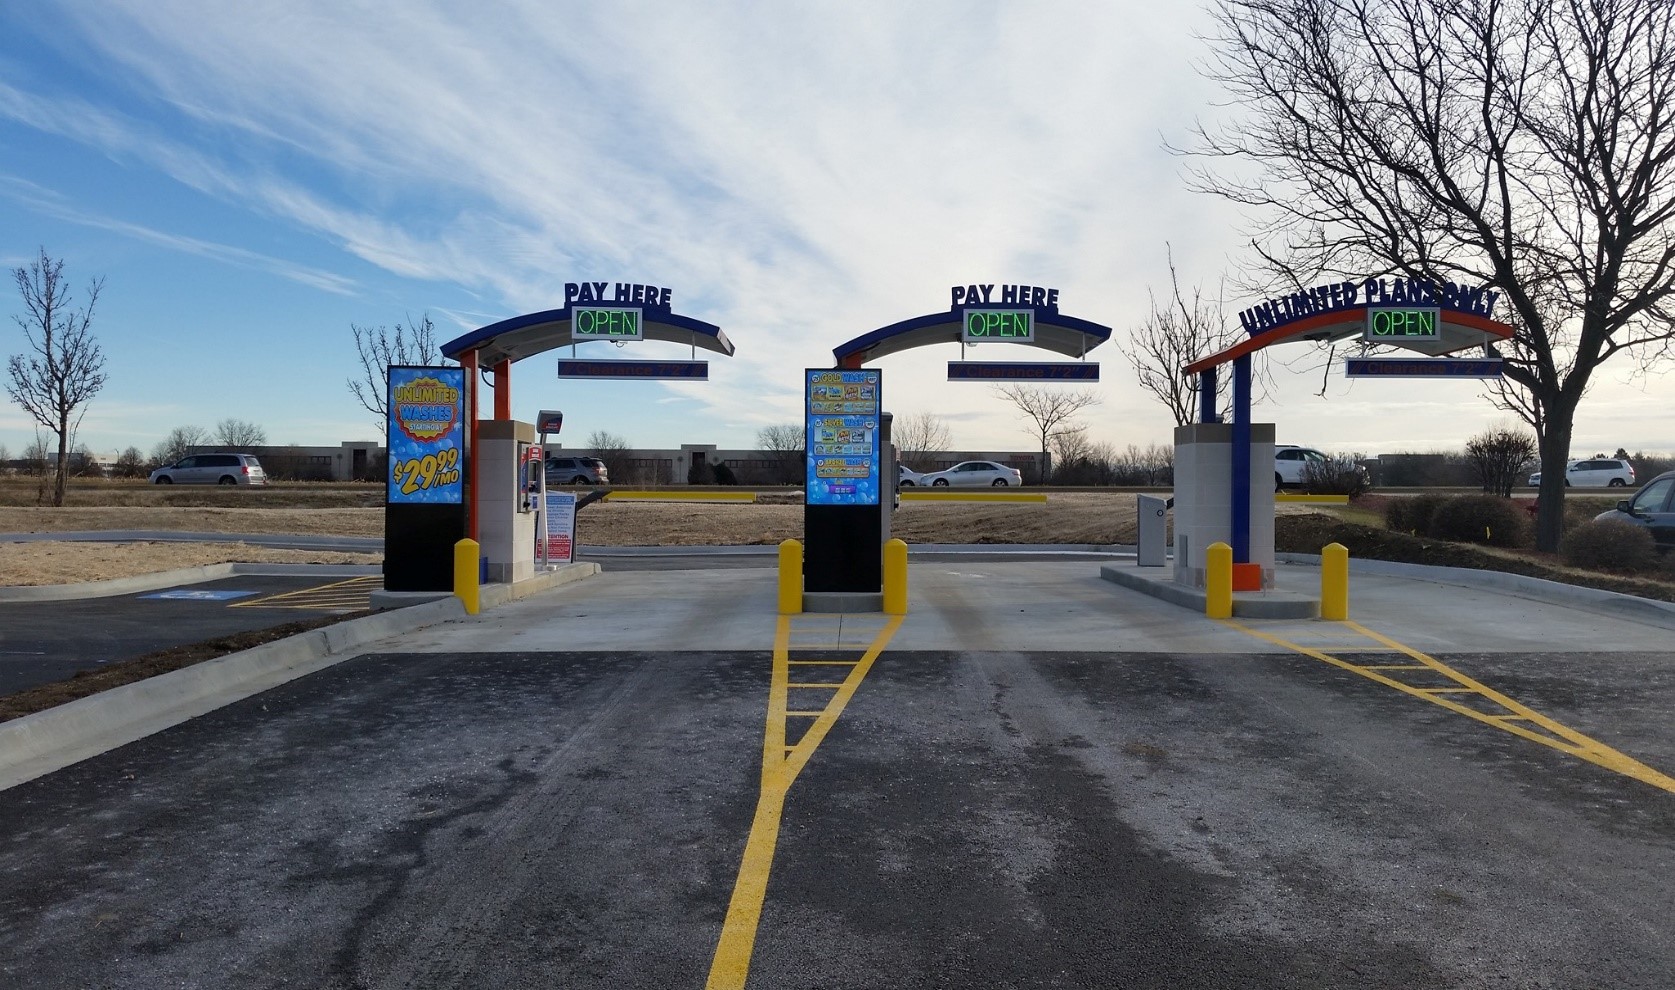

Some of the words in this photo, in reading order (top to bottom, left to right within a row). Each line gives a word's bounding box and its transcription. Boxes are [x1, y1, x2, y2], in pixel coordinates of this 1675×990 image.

[564, 282, 608, 303] PAY
[615, 282, 672, 307] HERE
[951, 284, 994, 306] PAY
[1002, 284, 1059, 308] HERE
[1239, 282, 1358, 332] UNLIMITED
[1365, 278, 1438, 305] PLANS
[578, 310, 636, 335] OPEN
[969, 312, 1028, 337] OPEN
[1373, 311, 1433, 336] OPEN
[576, 364, 653, 376] Clearance
[821, 371, 841, 382] GOLD
[842, 371, 865, 383] WASH
[967, 365, 1044, 378] Clearance
[1367, 362, 1446, 375] Clearance
[393, 386, 459, 404] UNLIMITED
[400, 405, 453, 421] WASHES
